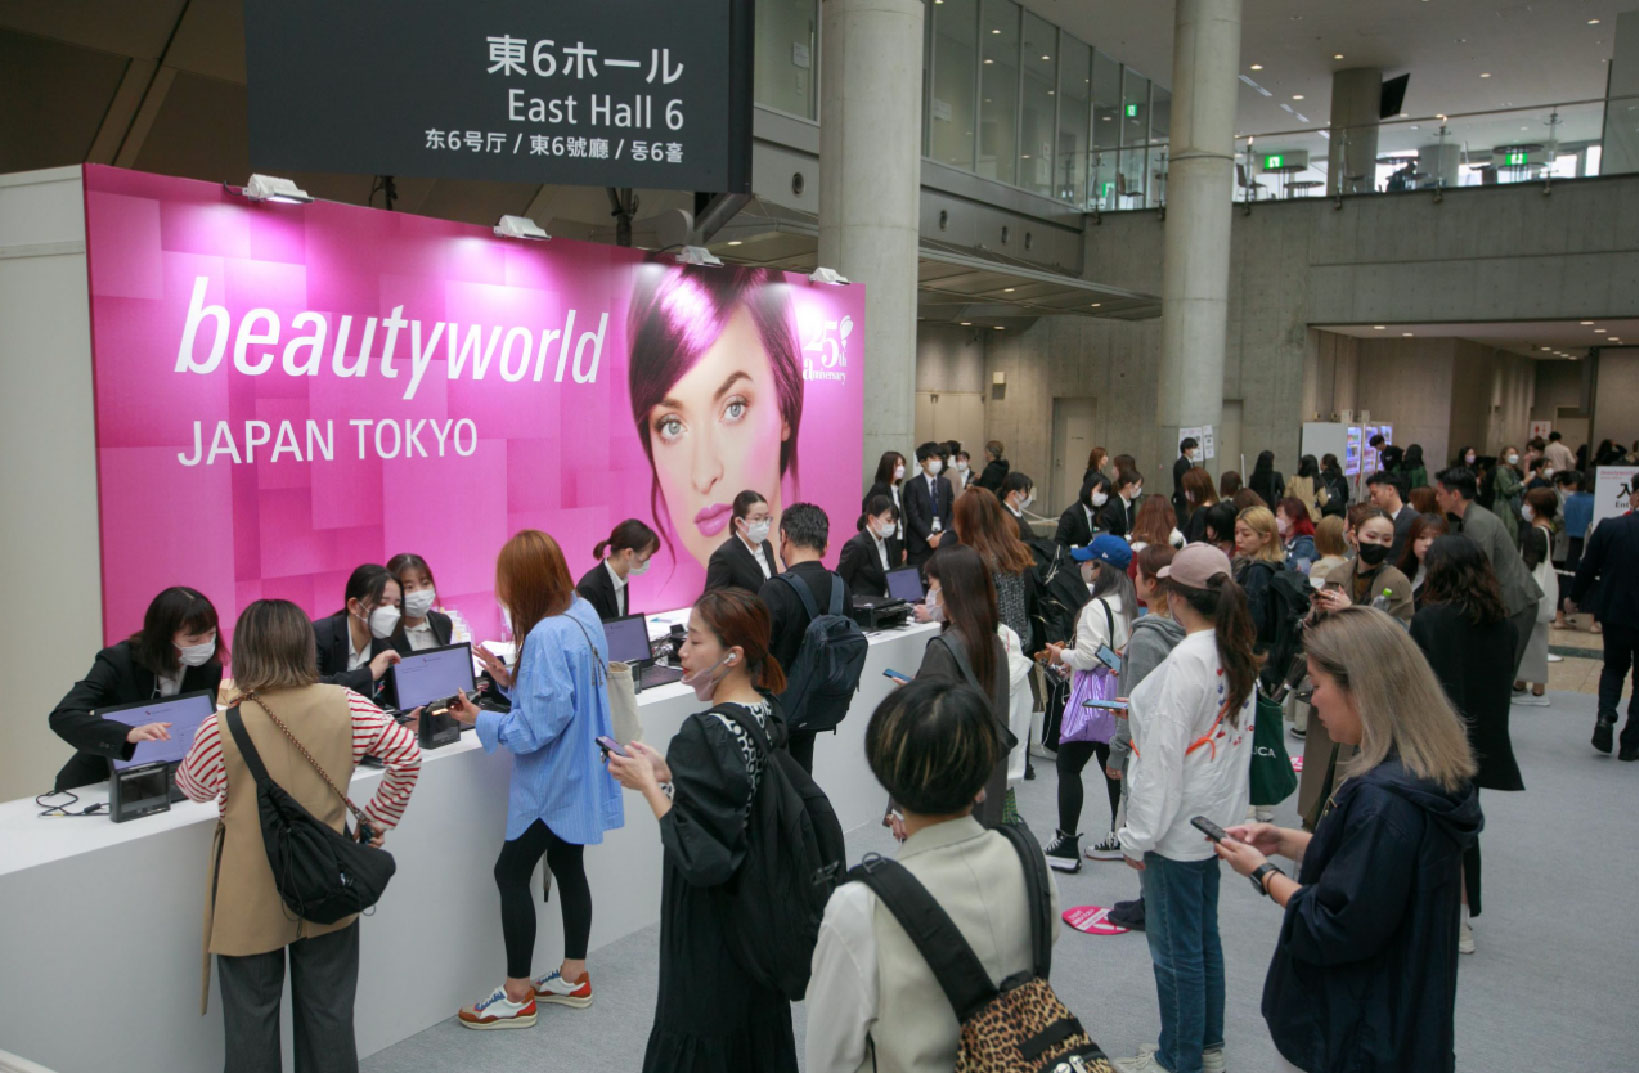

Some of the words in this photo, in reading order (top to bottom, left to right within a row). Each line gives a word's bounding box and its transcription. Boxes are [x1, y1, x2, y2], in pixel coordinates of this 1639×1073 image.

[485, 34, 684, 85] 東6ホール
[508, 89, 578, 124] East
[591, 94, 651, 128] Hall
[665, 98, 684, 131] 6
[425, 128, 507, 153] 东6号厅
[174, 276, 609, 400] beautyworld
[178, 420, 334, 467] JAPAN
[349, 418, 478, 460] TOKYO
